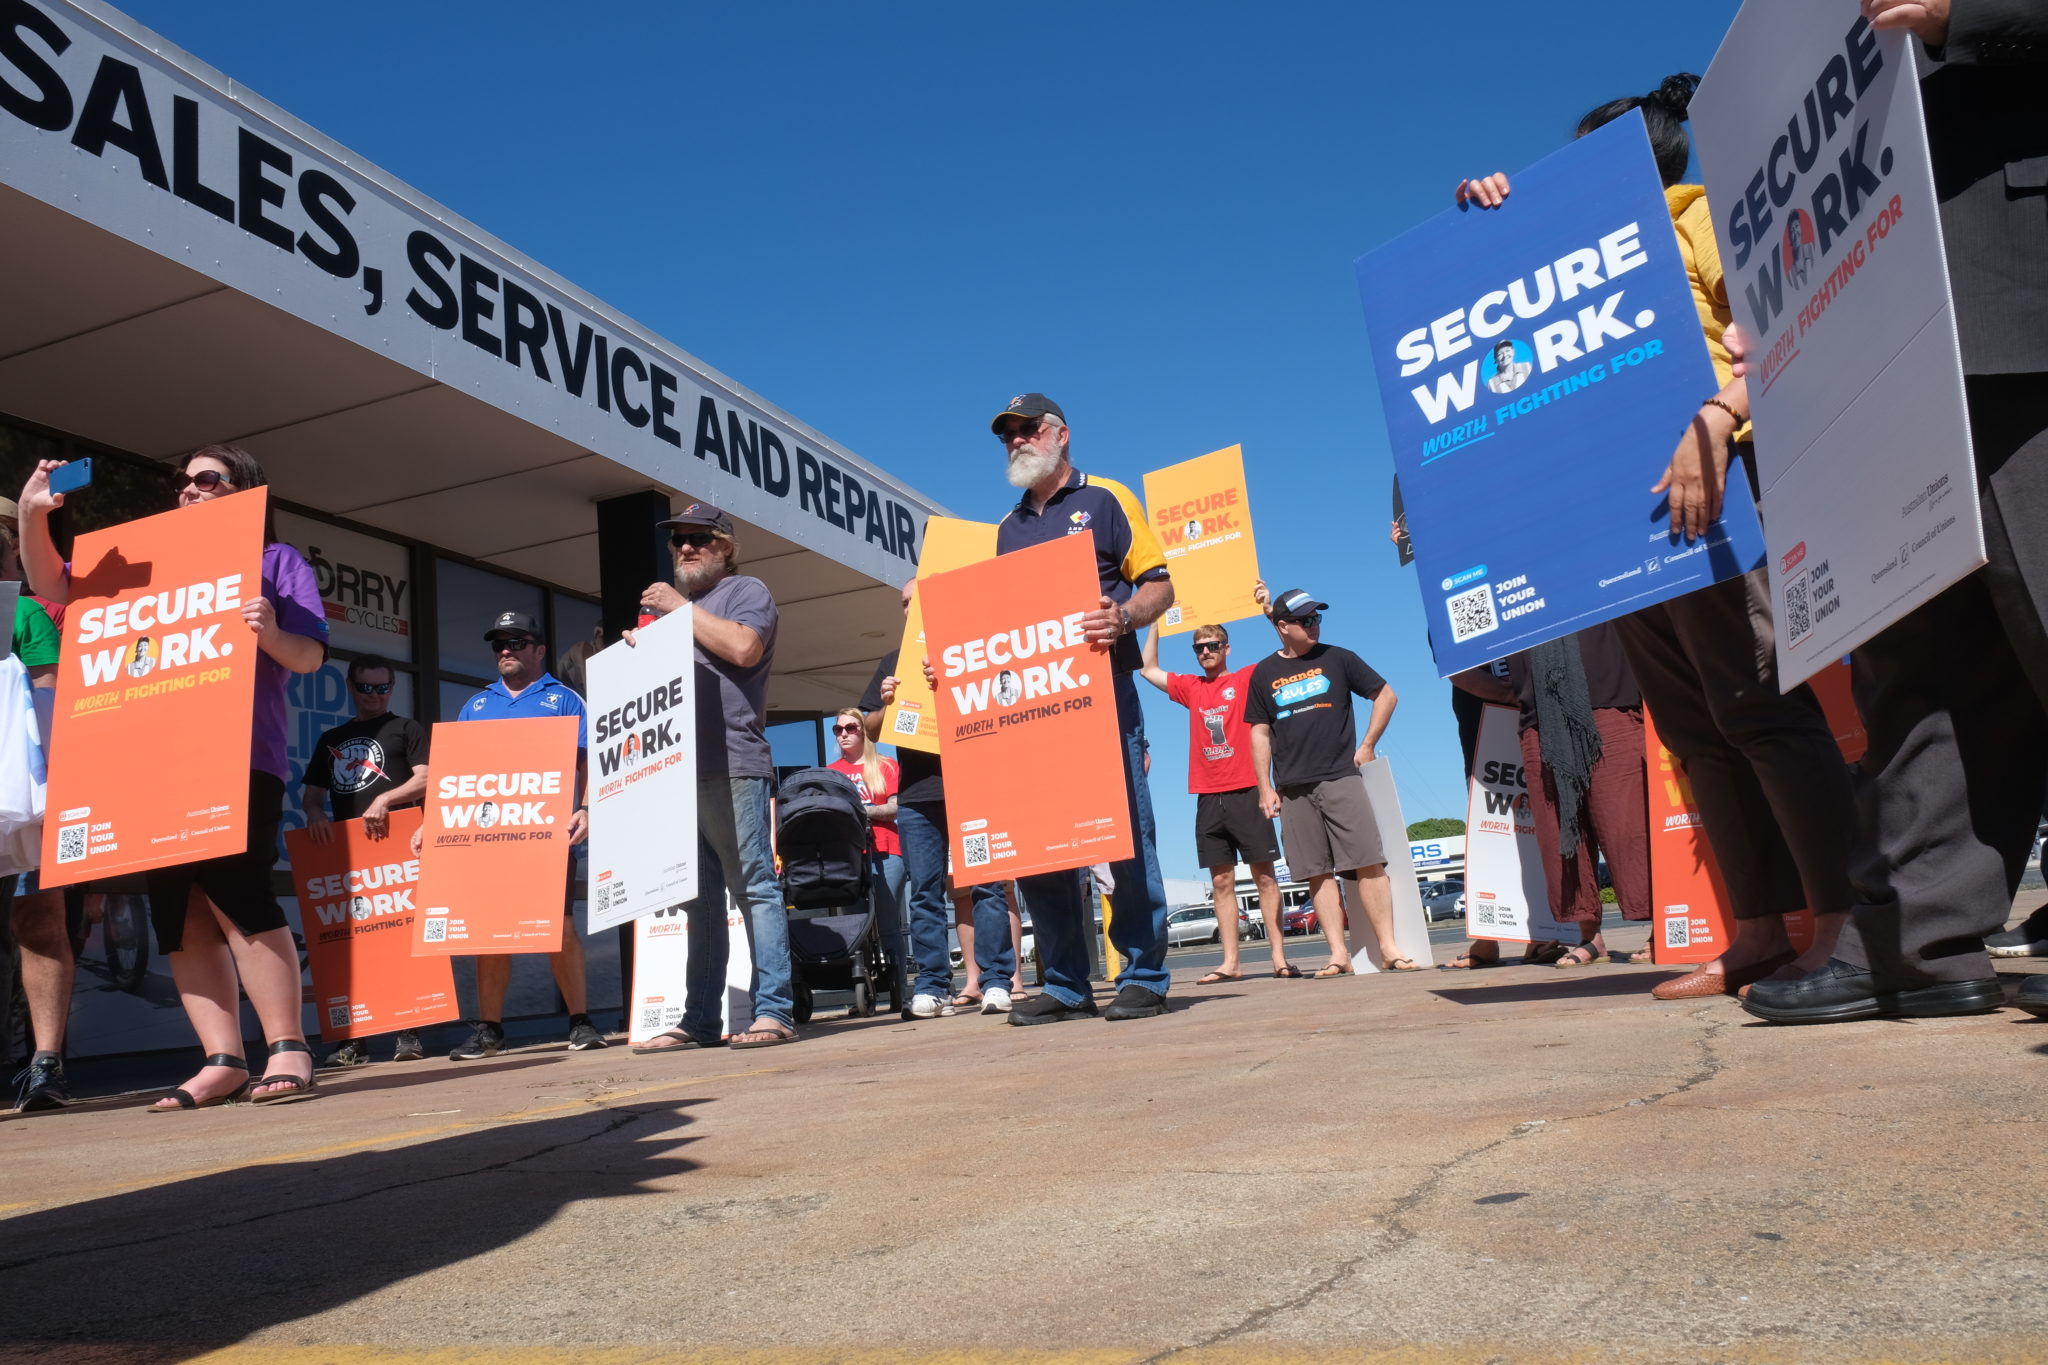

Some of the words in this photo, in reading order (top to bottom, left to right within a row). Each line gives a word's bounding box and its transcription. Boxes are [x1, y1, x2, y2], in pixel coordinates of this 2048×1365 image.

[1729, 15, 1883, 271] SECURE
[0, 0, 383, 316] SALES,
[406, 230, 681, 448] SERVICE
[694, 396, 790, 498] AND
[796, 446, 928, 566] REPAIR
[1760, 324, 1795, 385] WORTH
[1799, 240, 1866, 337] FIGHTING
[1867, 194, 1904, 254] FOR
[1396, 221, 1648, 377] SECURE
[1422, 415, 1487, 457] WORTH
[1495, 364, 1605, 425] FIGHTING
[1610, 338, 1664, 374] FOR
[1156, 488, 1239, 526] SECURE
[1163, 546, 1186, 557] WORTH
[1188, 537, 1224, 552] FIGHTING
[1225, 531, 1241, 541] FOR
[1495, 574, 1527, 594] JOIN
[1811, 559, 1829, 583] JOIN
[310, 555, 407, 615] ORRY
[1498, 586, 1536, 607] YOUR
[1812, 577, 1834, 603] YOUR
[77, 573, 242, 644] SECURE
[345, 607, 399, 635] CYCLES
[1501, 597, 1545, 621] UNION
[1815, 595, 1840, 623] UNION
[942, 611, 1087, 678] SECURE
[74, 691, 119, 712] WORTH
[125, 675, 195, 701] FIGHTING
[199, 667, 231, 686] FOR
[1271, 668, 1323, 690] Change
[1282, 680, 1323, 700] RULES
[596, 676, 683, 743] SECURE
[956, 719, 994, 737] WORTH
[999, 704, 1061, 728] FIGHTING
[1064, 696, 1093, 713] FOR
[438, 771, 561, 799] SECURE
[599, 778, 622, 797] WORTH
[625, 760, 663, 786] FIGHTING
[664, 752, 682, 769] FOR
[1483, 761, 1527, 789] SEC
[90, 832, 115, 844] YOUR
[91, 821, 112, 832] JOIN
[436, 834, 470, 844] WORTH
[474, 832, 527, 842] FIGHTING
[529, 831, 553, 840] FOR
[990, 832, 1008, 841] JOIN
[1480, 820, 1510, 832] WORTH
[1514, 824, 1536, 835] FIGH
[90, 842, 118, 855] UNION
[991, 841, 1013, 850] YOUR
[992, 849, 1017, 860] UNION
[306, 859, 420, 899] SECURE
[315, 889, 416, 926] WORK
[355, 919, 403, 935] FIGHTING
[649, 923, 682, 935] WORTH
[1690, 918, 1707, 926] JOIN
[1690, 927, 1710, 935] YOUR
[1691, 936, 1713, 944] UNION
